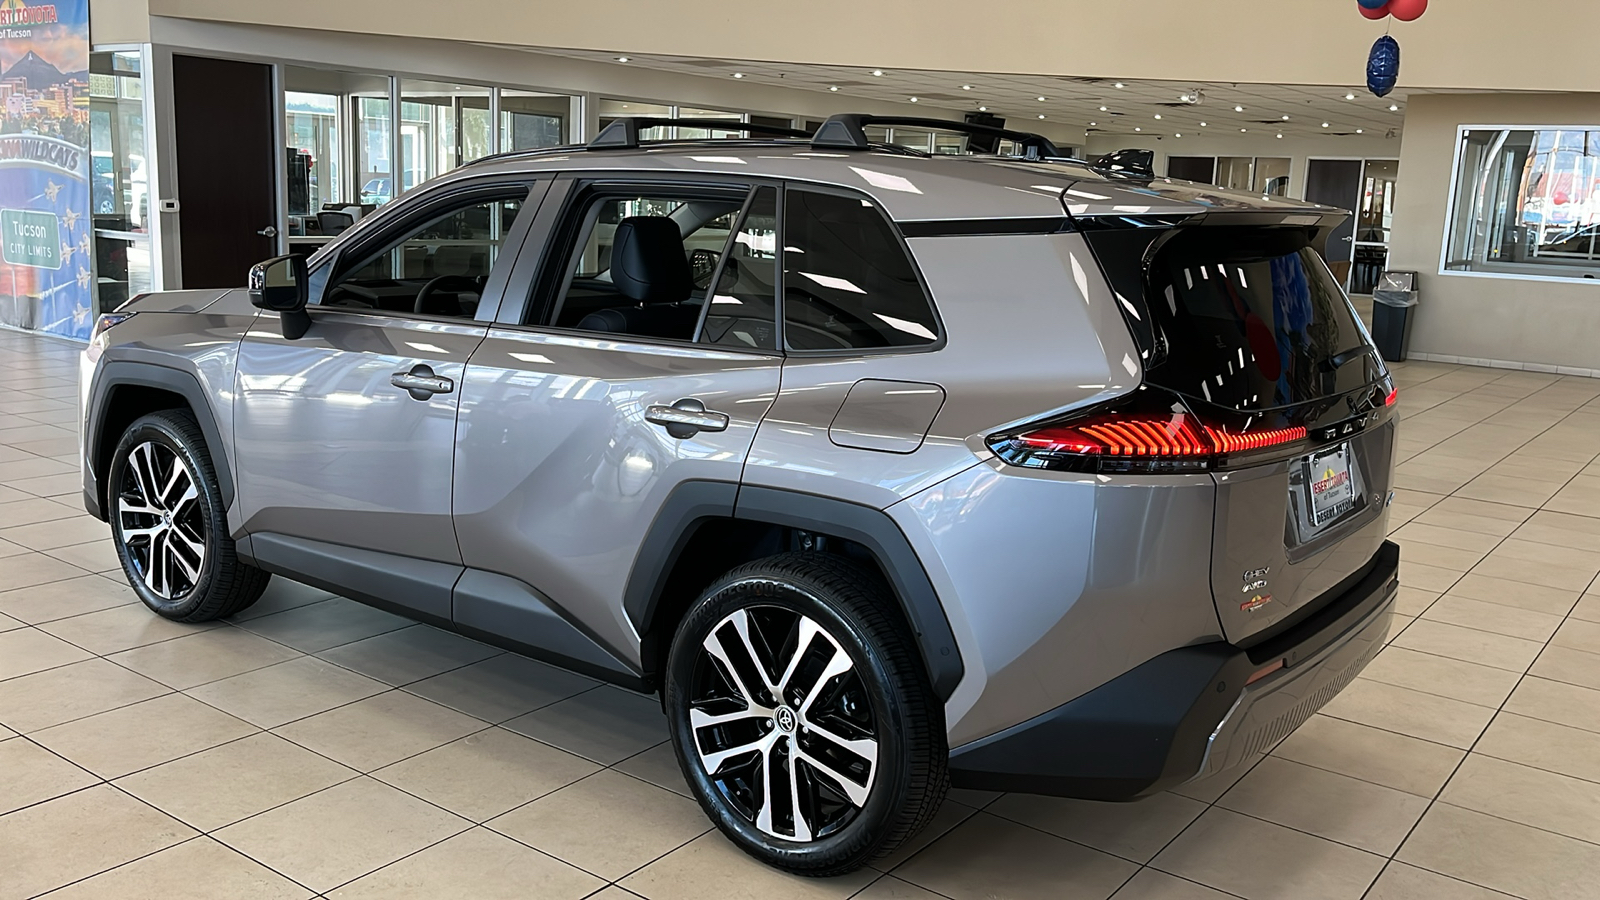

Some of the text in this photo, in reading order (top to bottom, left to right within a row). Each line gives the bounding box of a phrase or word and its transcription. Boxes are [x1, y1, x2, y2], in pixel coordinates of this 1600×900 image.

[15, 4, 58, 25] TOYOTA
[0, 28, 32, 39] of Tucson
[13, 220, 47, 239] Tucson
[10, 242, 52, 259] CITY LIMITS
[1316, 499, 1351, 524] DESERT TOYOT
